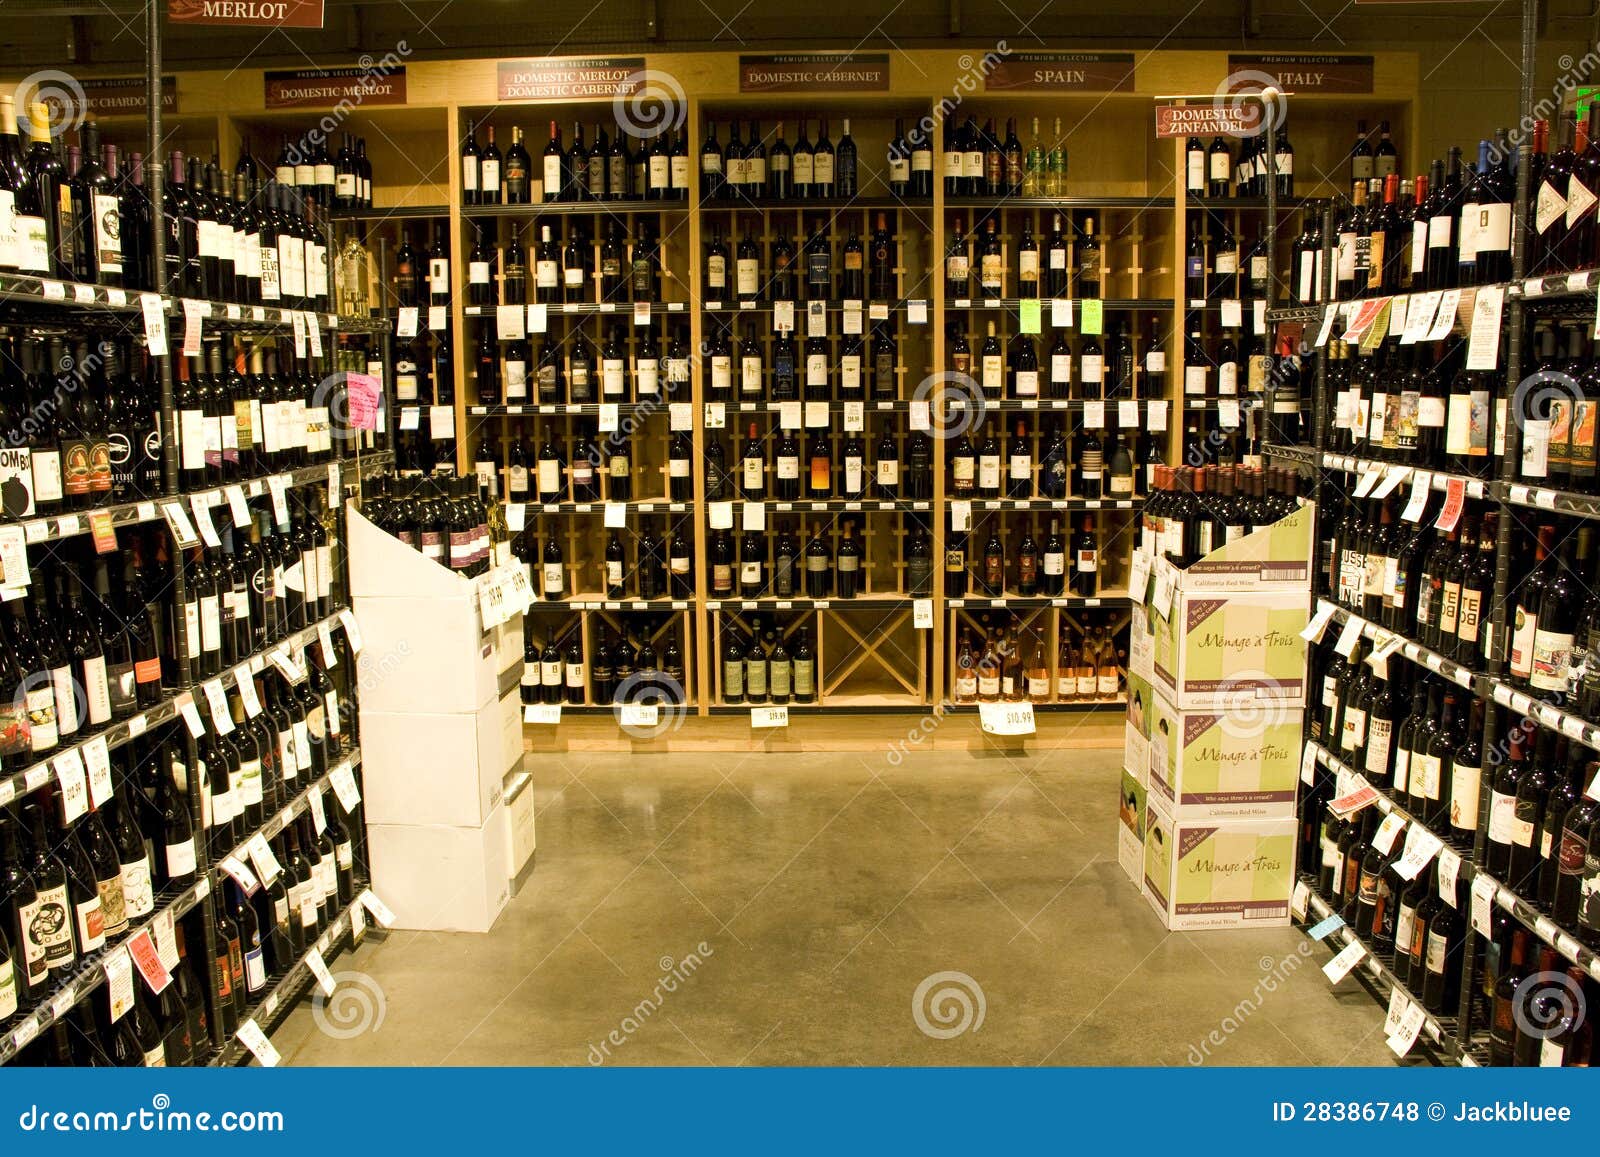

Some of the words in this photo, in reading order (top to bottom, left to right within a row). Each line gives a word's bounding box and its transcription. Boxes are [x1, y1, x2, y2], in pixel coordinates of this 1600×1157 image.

[203, 1, 287, 19] MERLOT
[514, 71, 576, 83] DOMESTIC
[579, 70, 630, 82] MERLOT
[749, 72, 813, 83] DOMESTIC
[815, 71, 881, 82] CABERNET
[1034, 70, 1086, 83] SPAIN
[1277, 72, 1324, 85] ITALY
[281, 87, 340, 99] DOMESTIC
[343, 84, 392, 96] MERLOT
[508, 84, 569, 97] DOMESTIC
[572, 83, 637, 95] CABERNET
[1172, 108, 1242, 121] DOMESTIC
[1169, 121, 1247, 134] ZINFANDEL
[1199, 633, 1251, 652] Ménage
[1254, 636, 1262, 647] à
[1264, 630, 1293, 647] Trois
[1007, 711, 1031, 724] $10.99
[1195, 747, 1246, 766] Ménage
[1250, 749, 1257, 761] à
[1260, 744, 1288, 760] Trois
[1243, 860, 1250, 871] à
[1253, 856, 1280, 871] Trois
